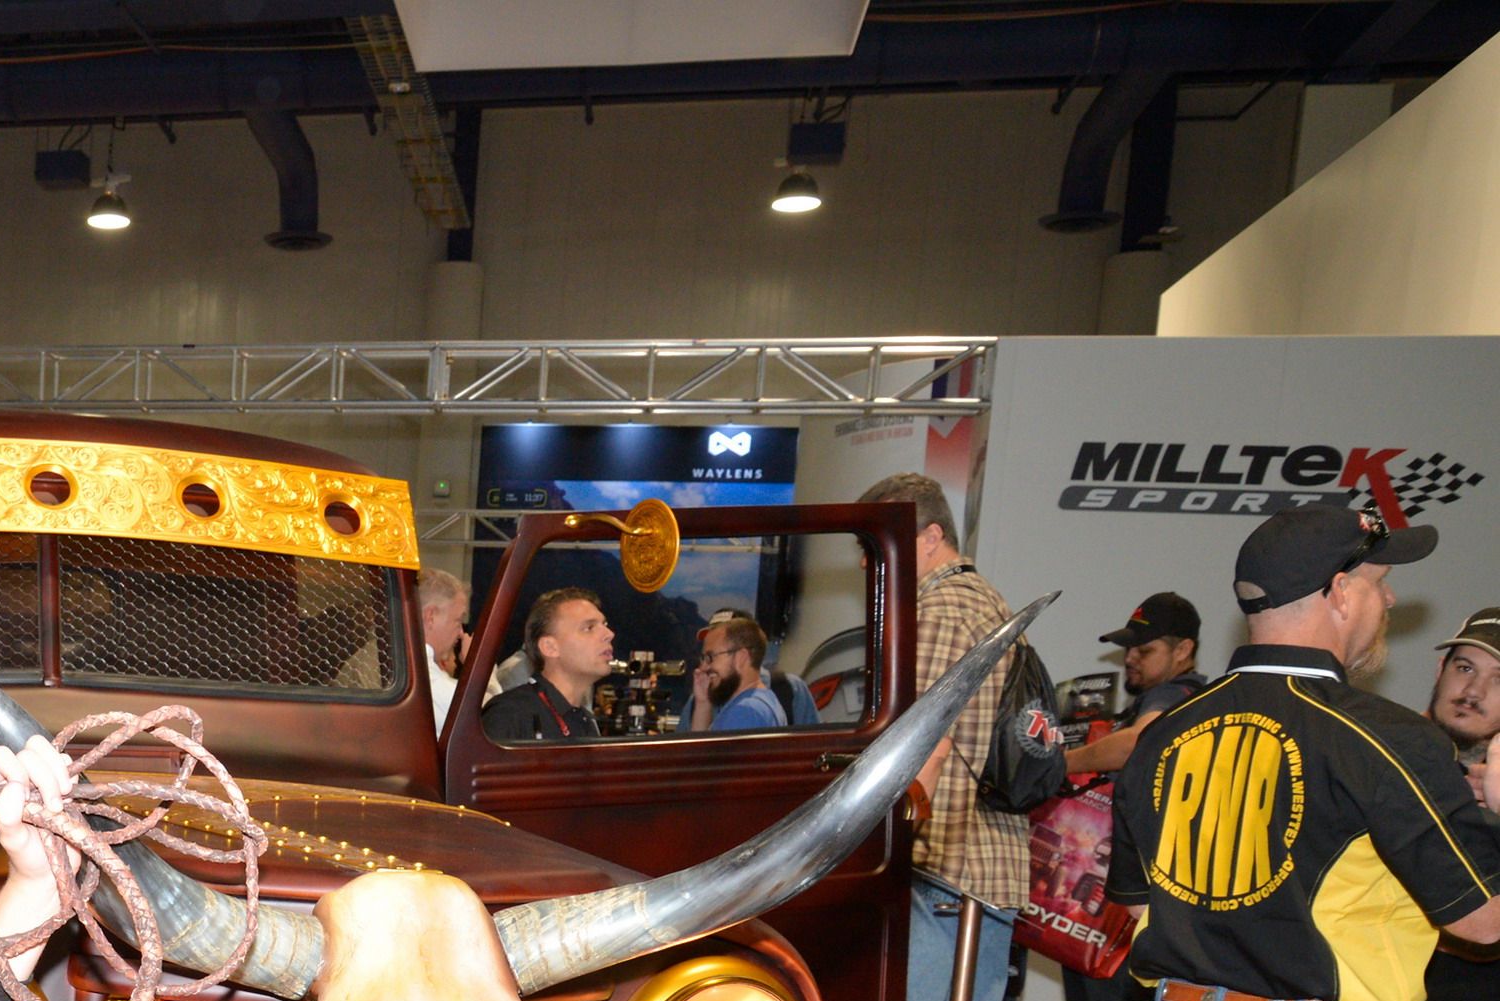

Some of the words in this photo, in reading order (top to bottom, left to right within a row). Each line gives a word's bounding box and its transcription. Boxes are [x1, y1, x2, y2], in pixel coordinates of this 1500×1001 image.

[692, 468, 763, 479] WAYLENS
[1077, 488, 1324, 513] SPORT
[1155, 725, 1282, 898] RNR
[1150, 858, 1199, 906] REDNEC
